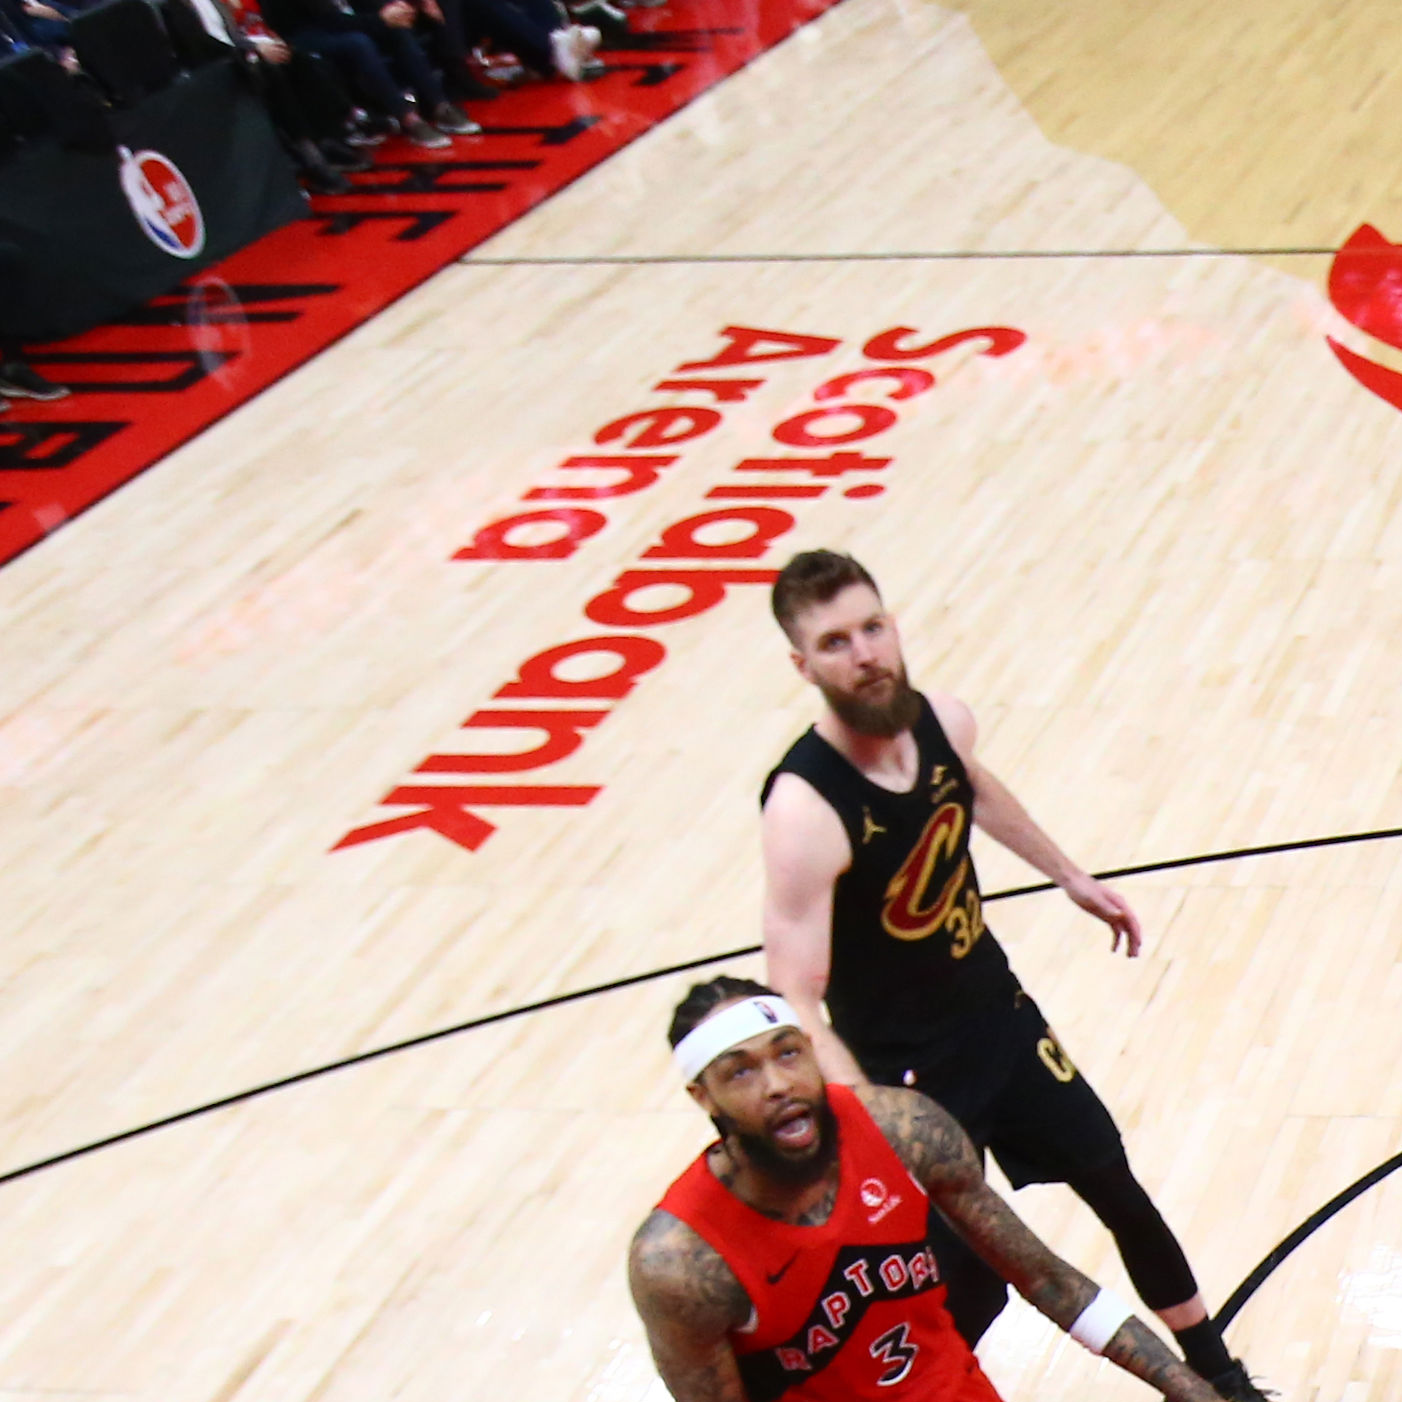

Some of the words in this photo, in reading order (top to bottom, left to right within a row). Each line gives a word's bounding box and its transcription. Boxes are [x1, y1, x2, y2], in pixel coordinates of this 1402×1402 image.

[0, 283, 344, 510] NOR
[450, 325, 843, 562] Arena
[328, 325, 1027, 854] Scotiabank
[869, 1321, 919, 1387] 3
